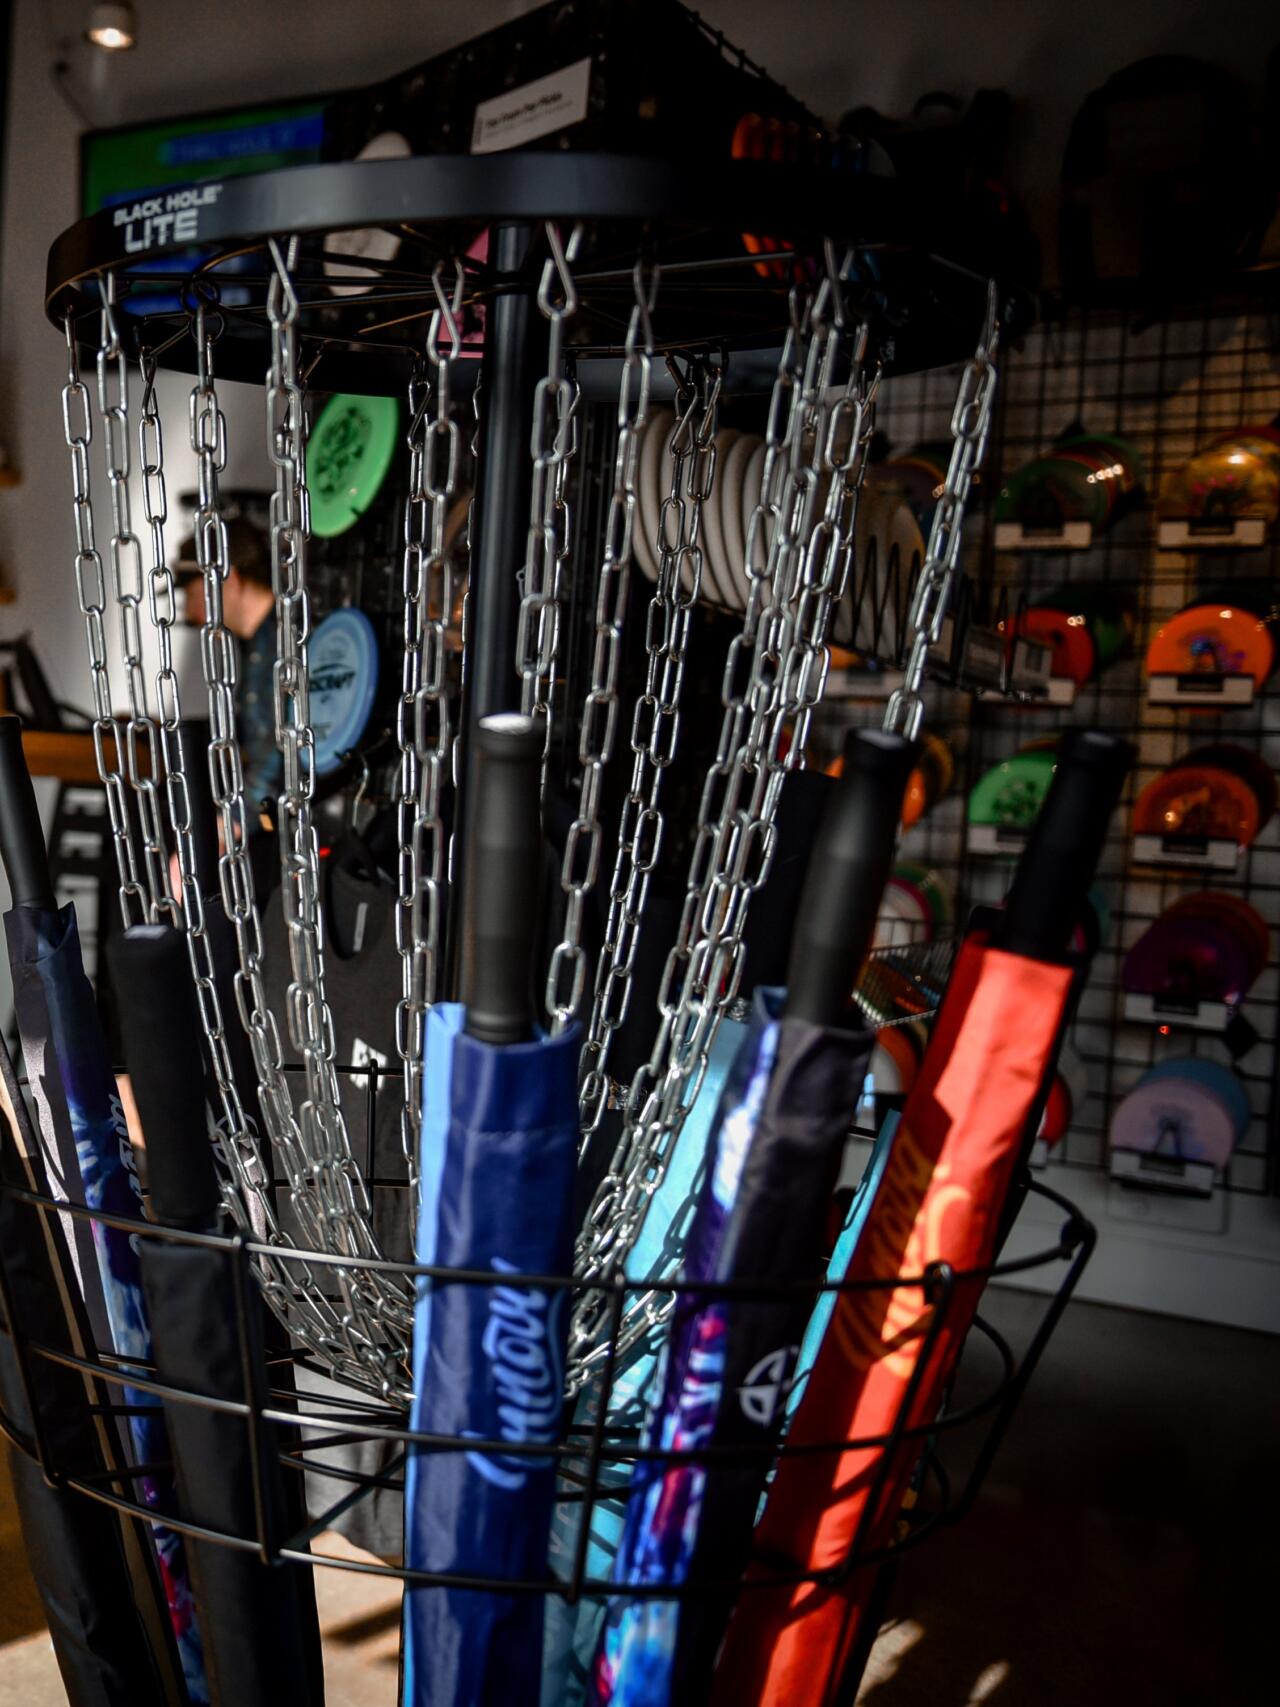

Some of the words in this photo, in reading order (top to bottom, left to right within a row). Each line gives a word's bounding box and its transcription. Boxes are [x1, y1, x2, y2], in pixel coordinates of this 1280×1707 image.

[113, 197, 163, 227] BLACK
[166, 185, 219, 212] HOLE
[125, 208, 198, 254] LITE
